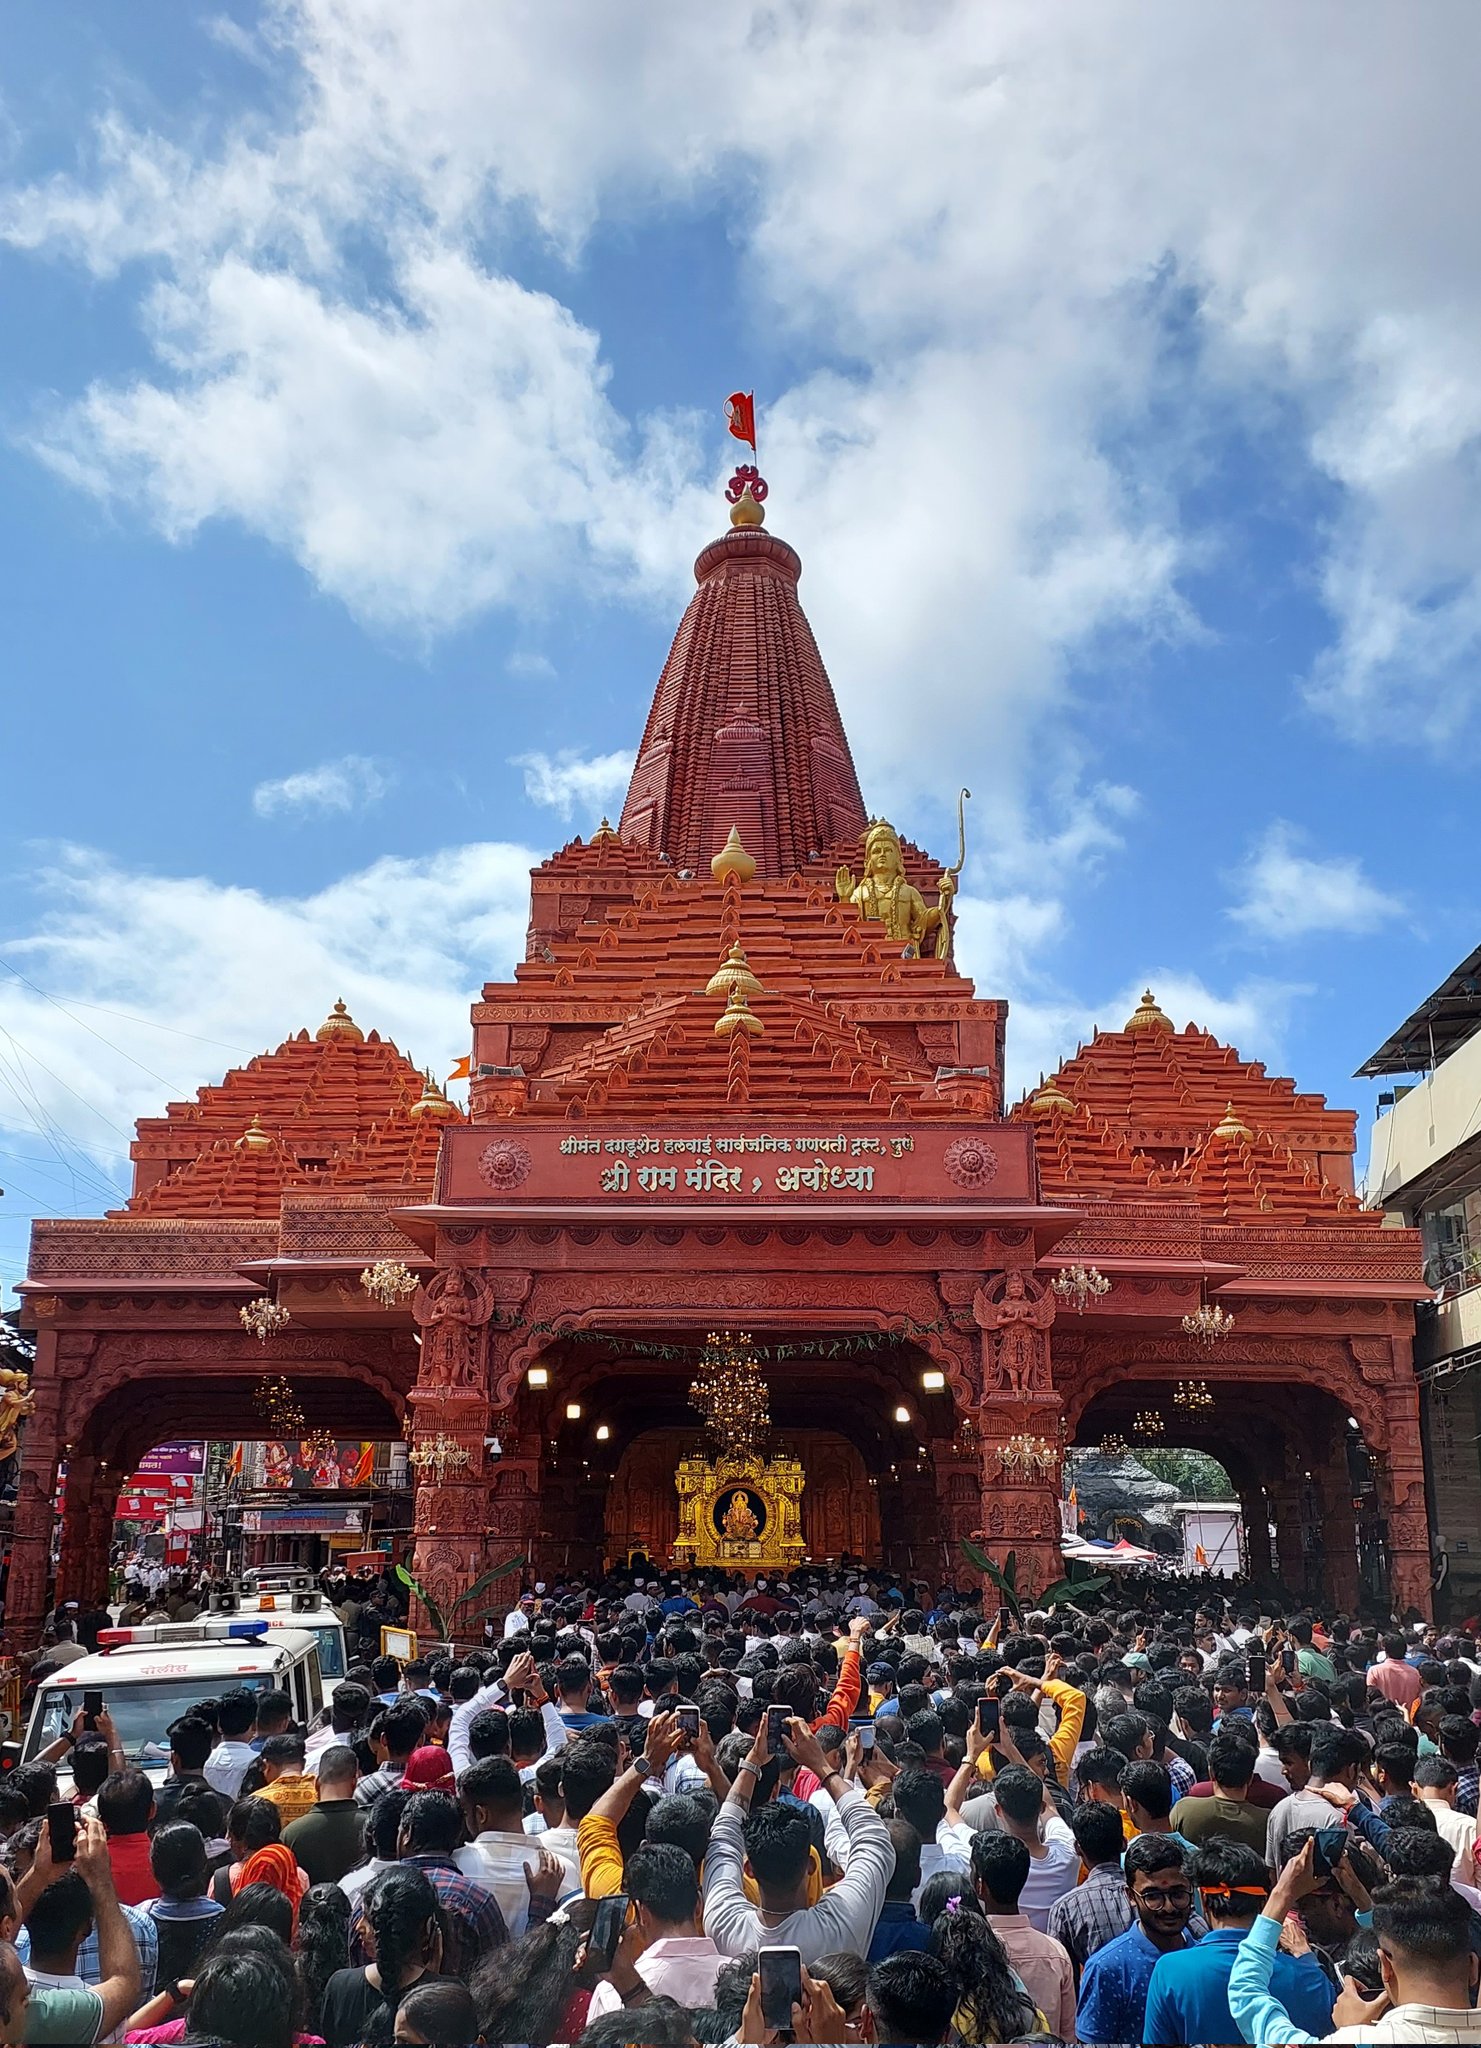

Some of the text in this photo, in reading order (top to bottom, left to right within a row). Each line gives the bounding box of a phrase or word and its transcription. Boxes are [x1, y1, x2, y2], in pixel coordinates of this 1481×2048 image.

[559, 1132, 915, 1158] श्रीमंत दगडूशेठ हलवाई सार्वजनिक गणपती ट्रस्ट, पुणे
[599, 1159, 631, 1192] श्री
[637, 1166, 678, 1192] राम
[685, 1158, 742, 1193] मंदिर
[775, 1158, 875, 1192] अयोध्या
[140, 1664, 189, 1675] पोलीस
